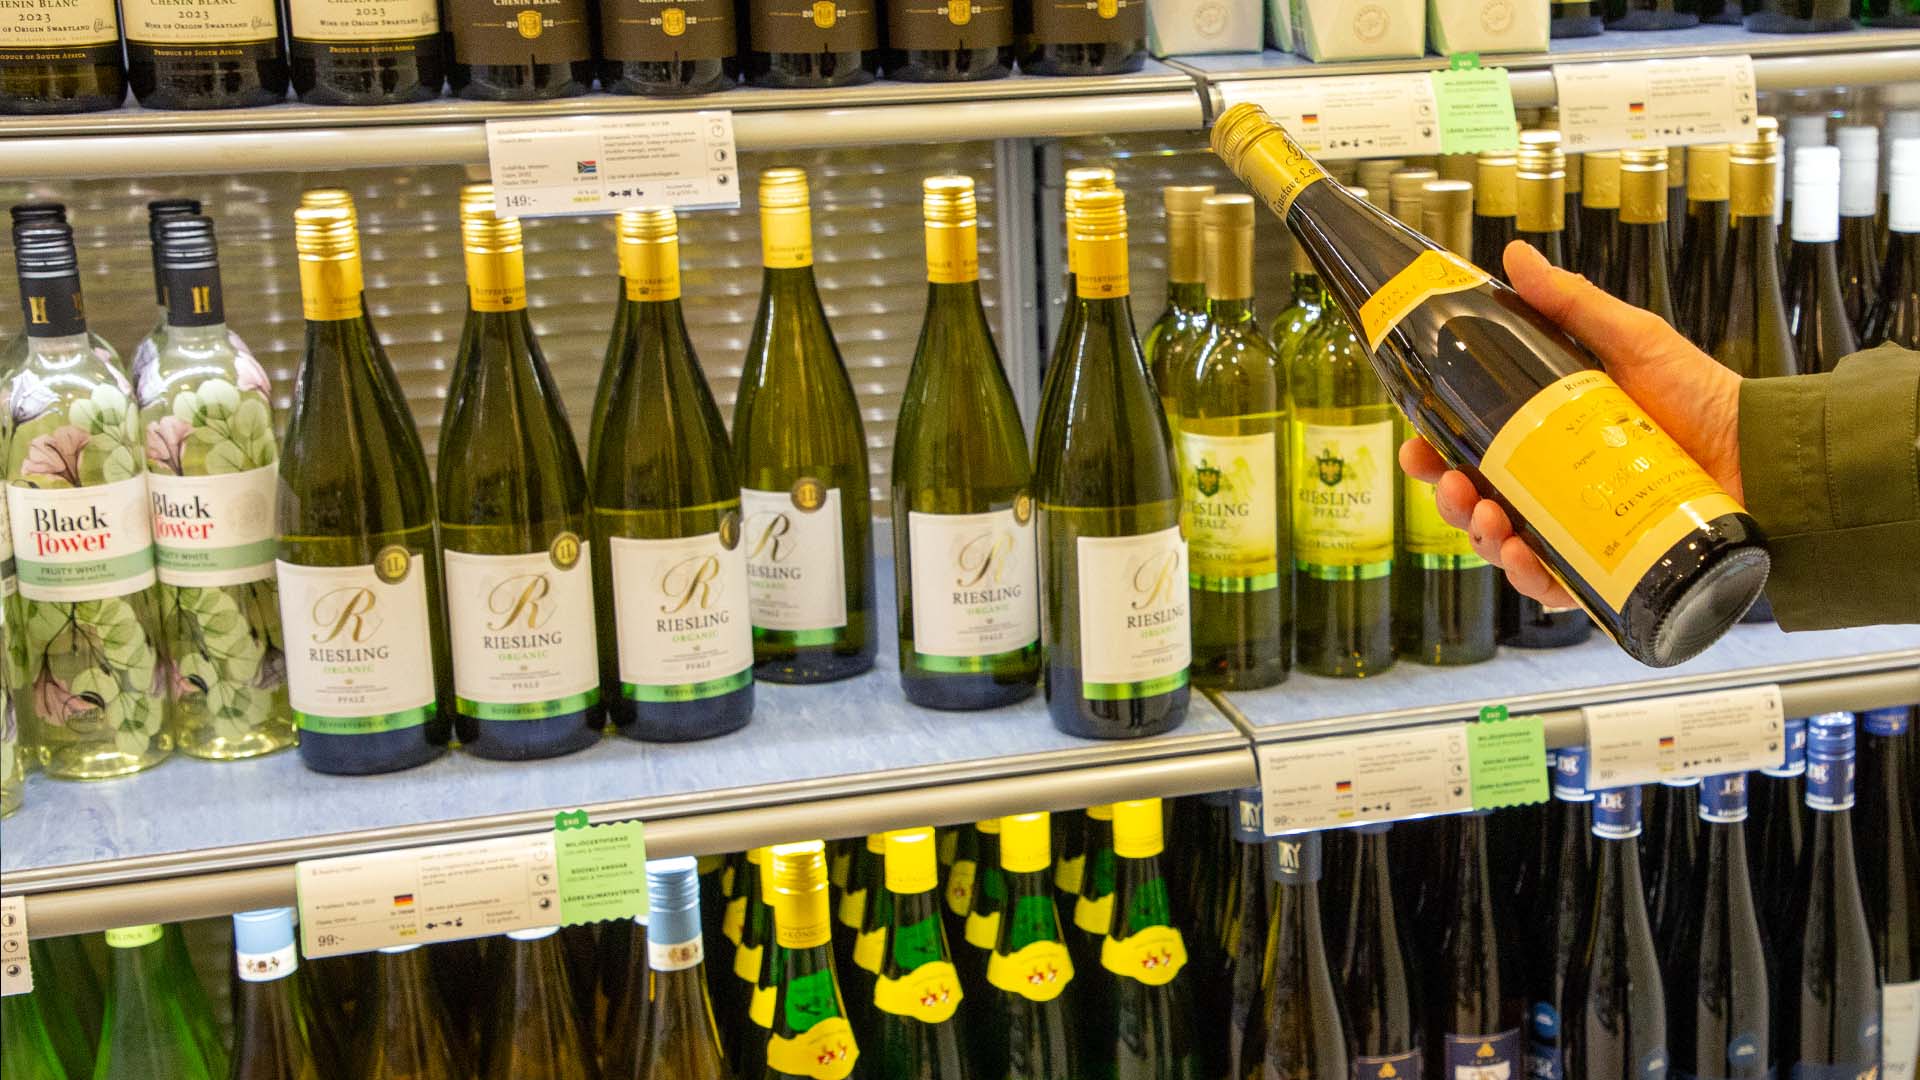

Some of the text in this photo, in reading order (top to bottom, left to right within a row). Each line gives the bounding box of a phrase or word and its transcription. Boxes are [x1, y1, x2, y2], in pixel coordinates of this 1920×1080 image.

[19, 13, 52, 22] 2023
[178, 11, 210, 20] 2023
[355, 8, 386, 17] 2023
[505, 196, 537, 208] 149:-
[33, 506, 109, 533] Black
[30, 529, 112, 557] Tower
[659, 553, 720, 614] R
[487, 573, 558, 632] R
[952, 584, 1022, 605] RIESLING
[312, 585, 385, 645] R
[656, 609, 730, 633] RIESLING
[484, 630, 563, 650] RIESLING
[309, 644, 391, 663] RIESLING
[317, 934, 345, 947] 99:-
